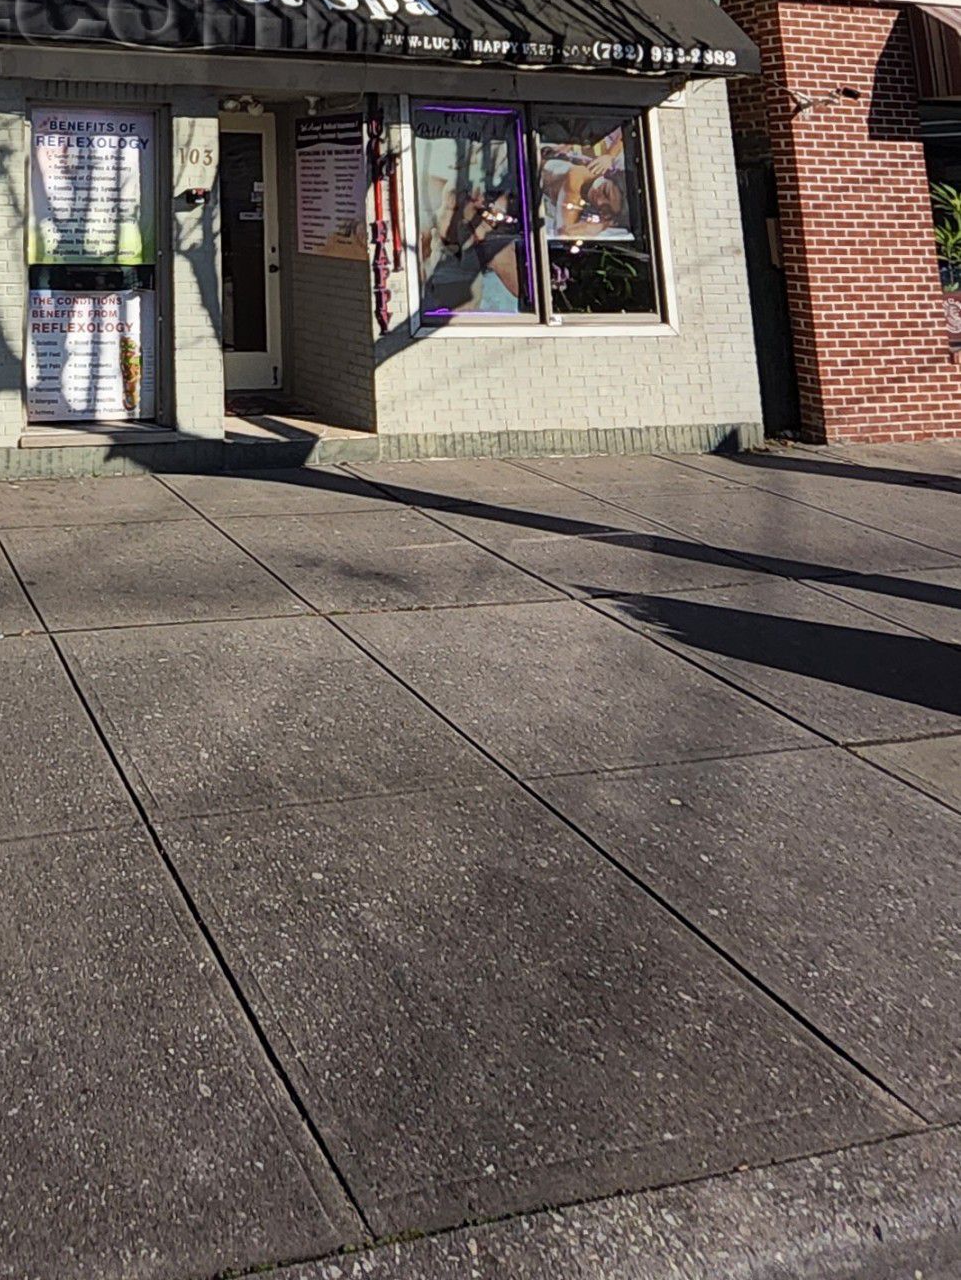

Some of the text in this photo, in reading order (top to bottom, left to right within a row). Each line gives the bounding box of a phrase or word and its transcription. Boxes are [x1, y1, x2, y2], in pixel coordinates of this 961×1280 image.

[593, 40, 644, 64] (732)
[50, 120, 136, 132] BENEFITS OF
[36, 135, 149, 149] REFLEXOLOGY
[178, 148, 213, 166] 103
[32, 297, 122, 306] THE CONDITIONS
[32, 310, 118, 318] BENEFITS FROM
[32, 322, 133, 333] REFLEXOLOGY
